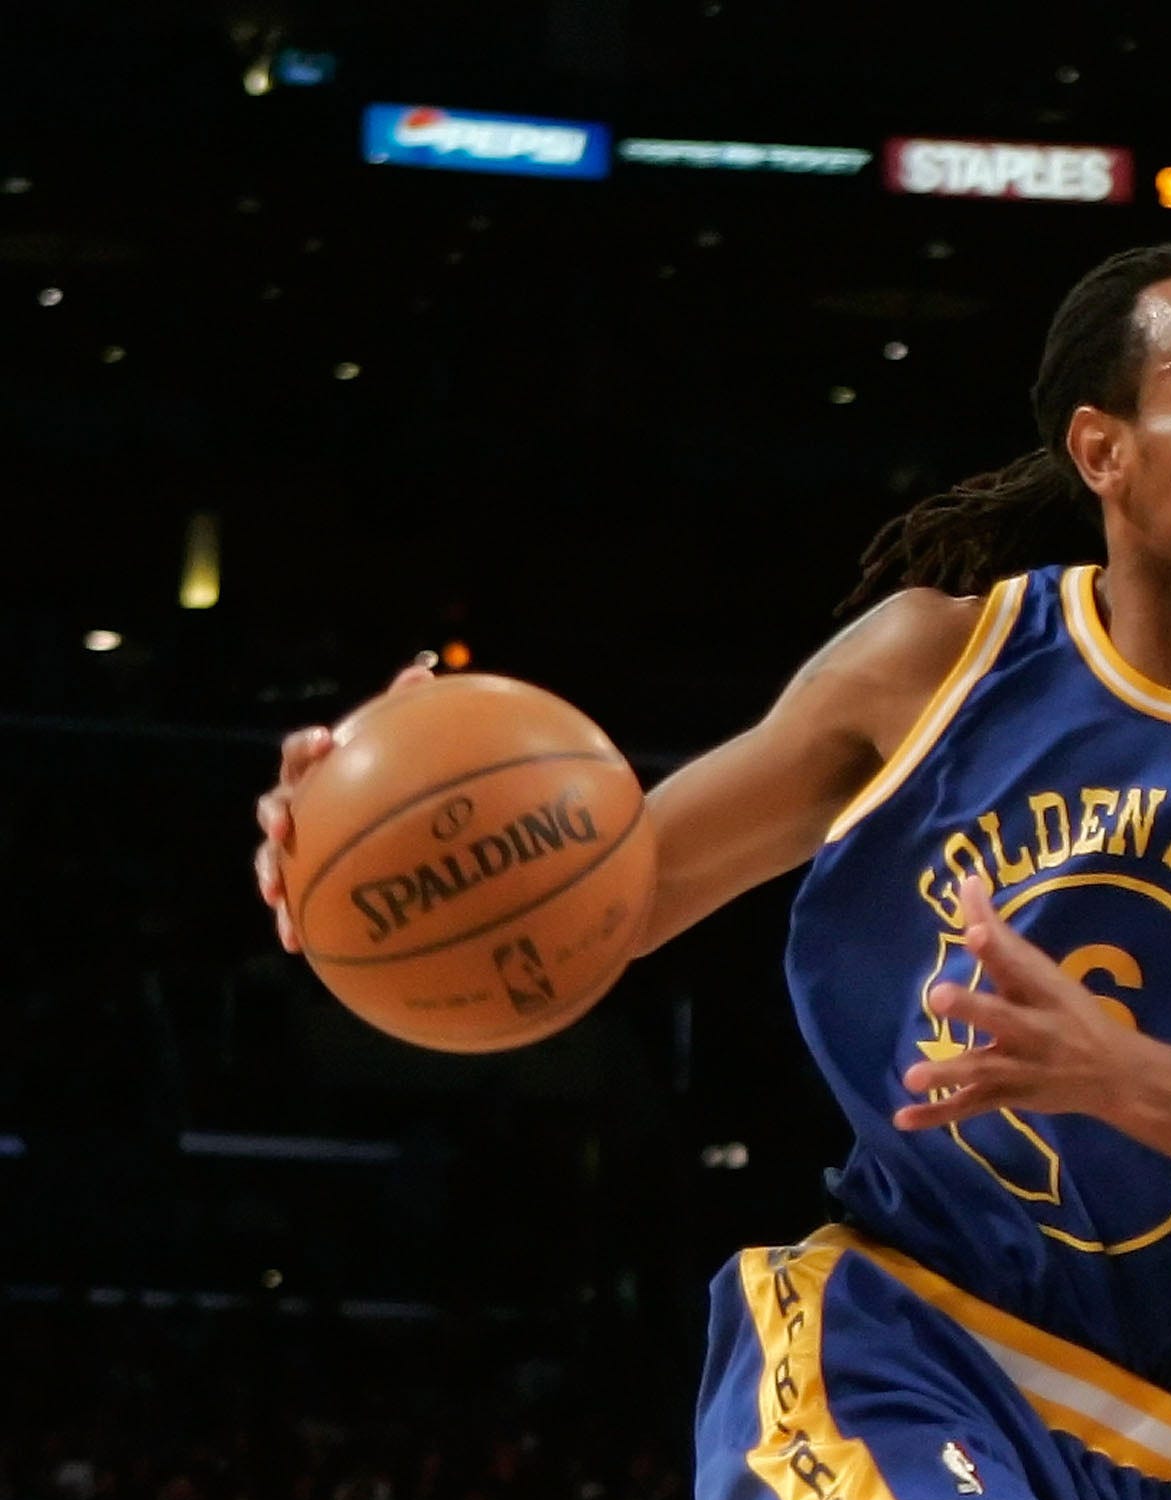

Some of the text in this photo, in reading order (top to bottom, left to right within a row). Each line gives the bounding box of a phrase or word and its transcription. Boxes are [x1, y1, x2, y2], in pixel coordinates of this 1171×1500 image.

[901, 139, 1114, 201] STAPLES
[350, 790, 599, 944] SPALDING
[917, 787, 1167, 930] GOLDEN
